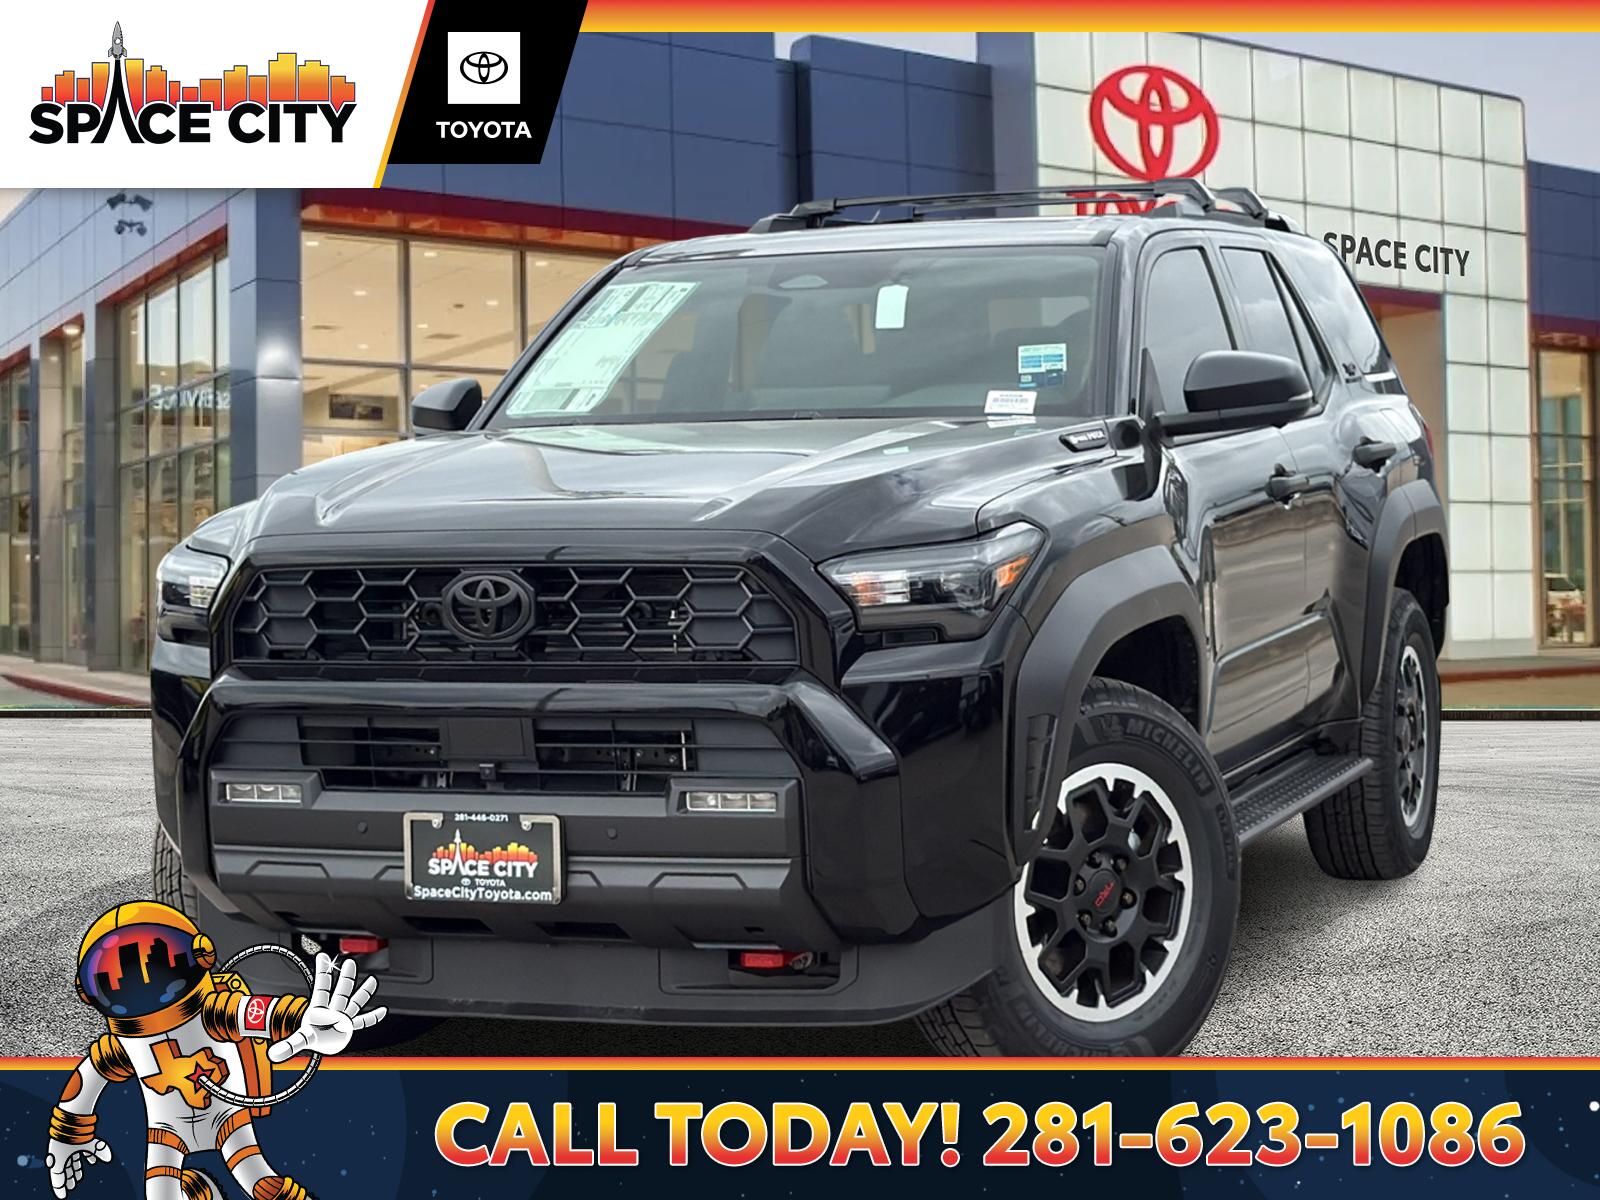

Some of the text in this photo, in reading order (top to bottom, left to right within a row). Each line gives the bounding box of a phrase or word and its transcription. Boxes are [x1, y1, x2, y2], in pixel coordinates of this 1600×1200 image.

[1323, 232, 1470, 277] SPACE CITY
[1126, 718, 1212, 793] MICHELIN
[428, 858, 538, 878] SPACE CITY
[474, 878, 506, 887] TOYOTA
[413, 885, 552, 901] SpaceCityToyota.com
